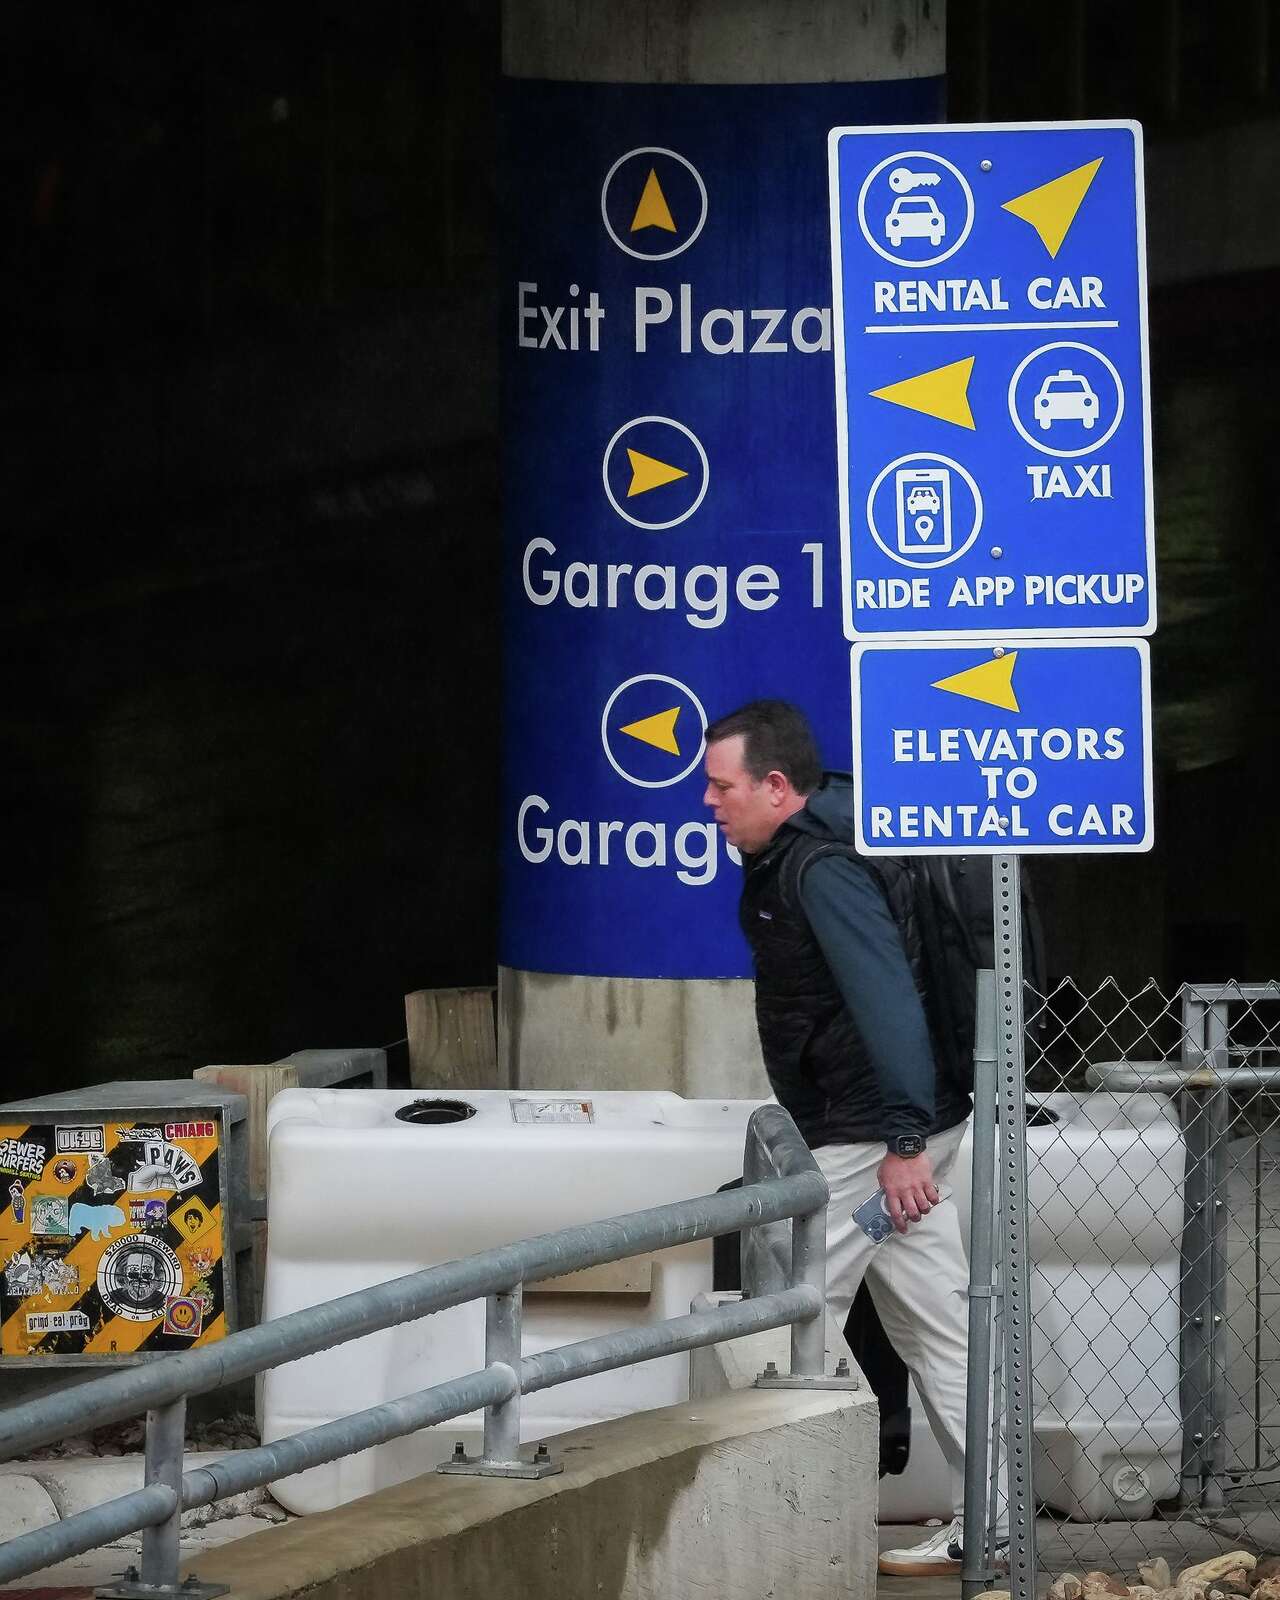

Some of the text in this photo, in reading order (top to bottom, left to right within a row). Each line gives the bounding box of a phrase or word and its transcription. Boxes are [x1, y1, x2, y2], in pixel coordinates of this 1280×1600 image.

[874, 276, 1106, 313] RENTAL CAR
[518, 281, 831, 355] Exit Plaza
[1027, 465, 1112, 500] TAXI
[523, 537, 823, 629] Garage 1
[856, 573, 1145, 609] RIDE APP PICKUP
[893, 727, 1126, 763] ELEVATORS
[981, 766, 1038, 800] TO
[871, 804, 1136, 838] RENTAL CAR
[165, 1122, 214, 1139] CHIANG
[0, 1138, 46, 1160] SEWER
[150, 1147, 196, 1185] PAWS
[151, 1238, 181, 1270] REWARD
[102, 1293, 123, 1315] DEAD
[151, 1305, 167, 1320] ALI
